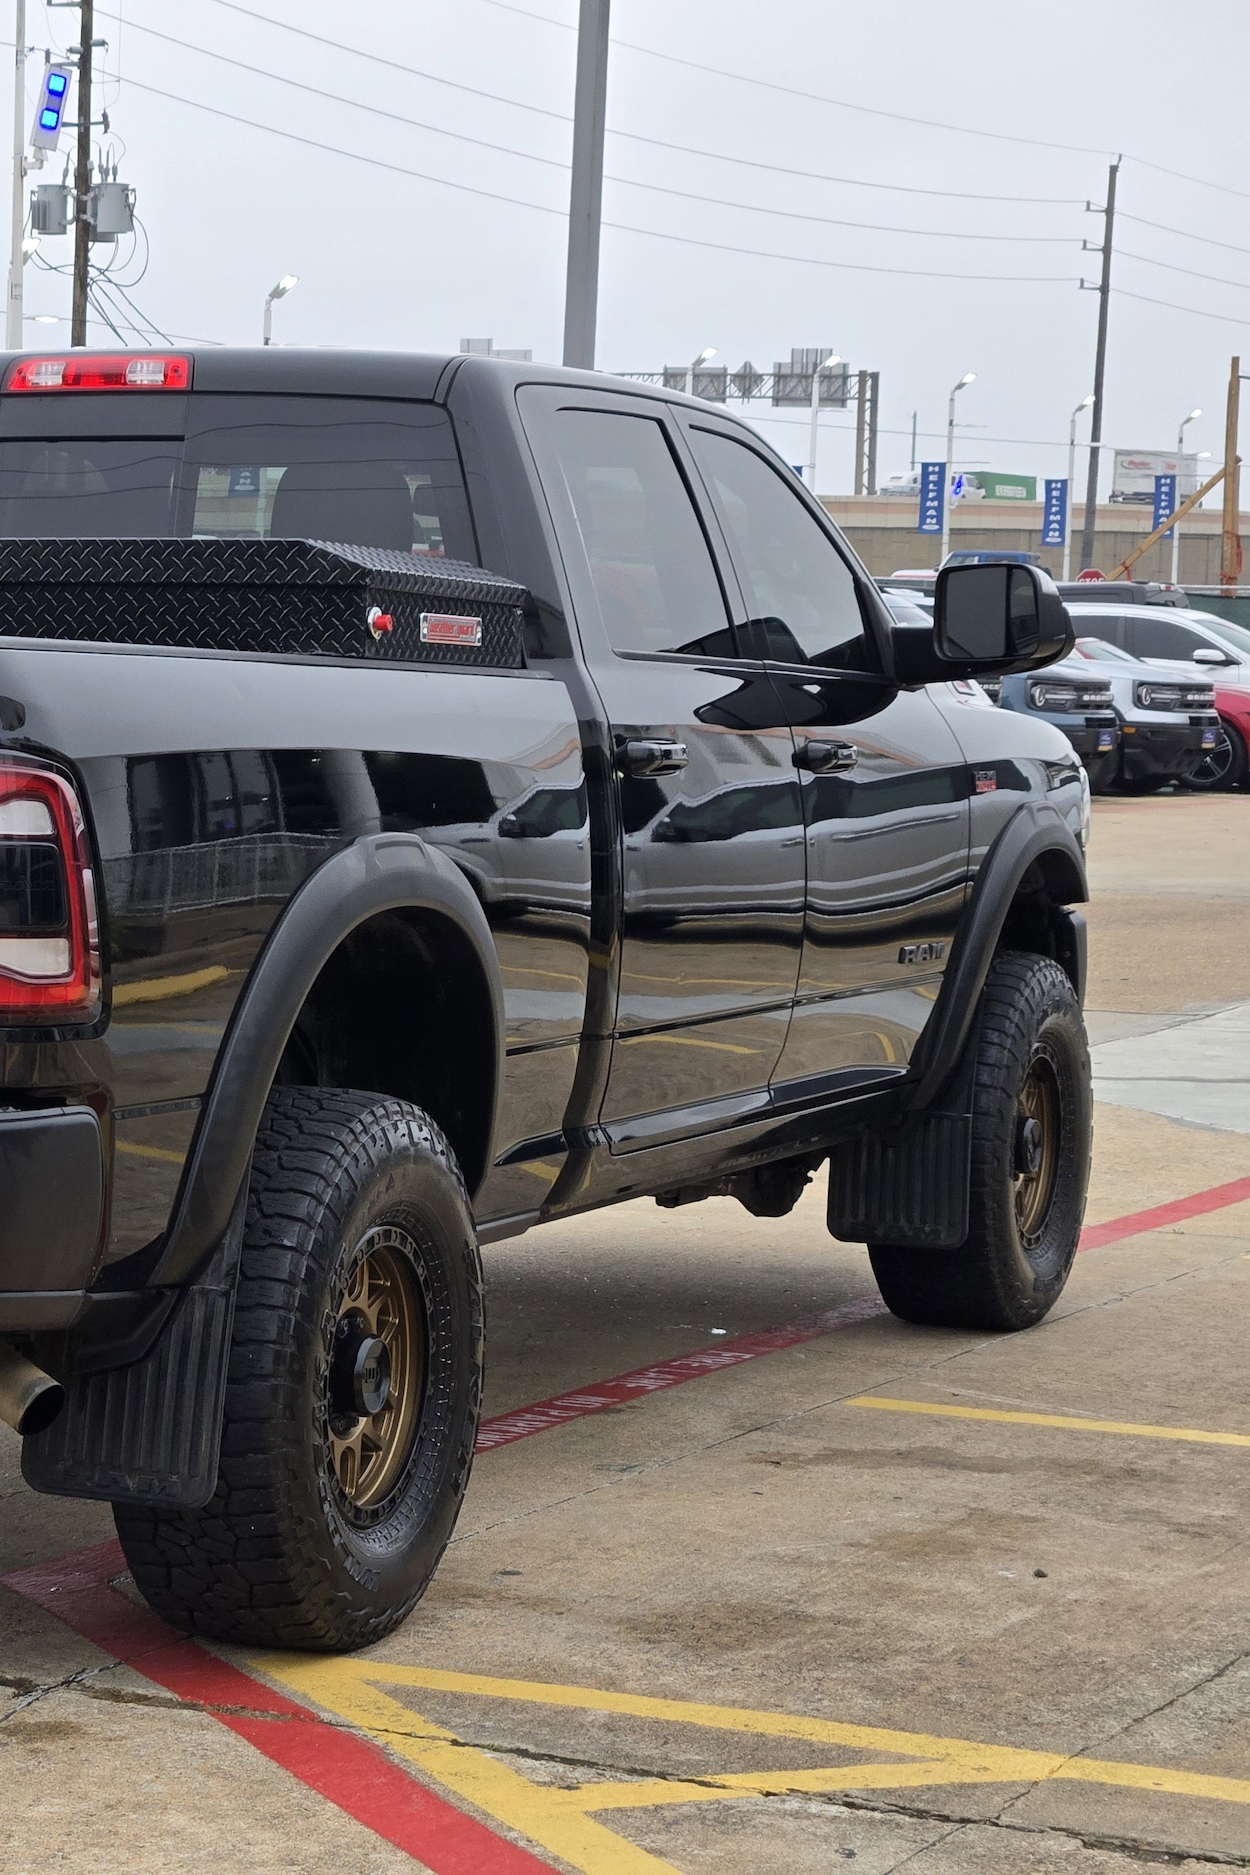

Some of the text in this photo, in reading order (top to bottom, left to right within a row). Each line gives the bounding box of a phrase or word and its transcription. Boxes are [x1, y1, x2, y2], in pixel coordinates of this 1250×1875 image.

[926, 465, 940, 525] HELFMAN
[1049, 481, 1062, 537] HELFMAN
[1159, 477, 1171, 530] HELFMA
